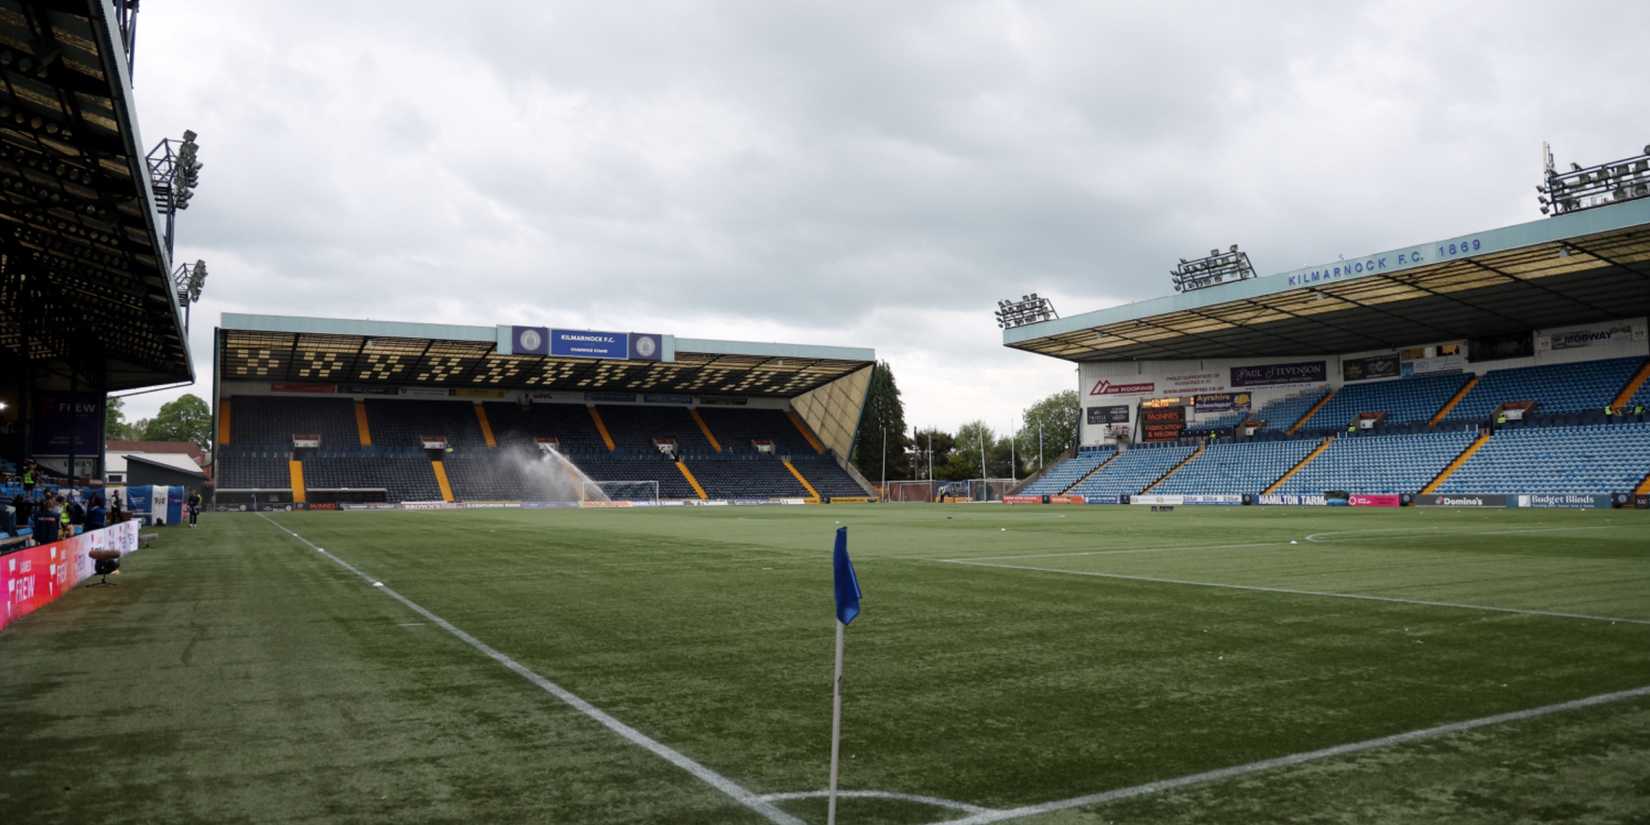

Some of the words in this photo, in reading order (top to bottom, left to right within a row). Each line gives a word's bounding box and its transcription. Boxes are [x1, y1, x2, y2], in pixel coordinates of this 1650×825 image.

[1288, 257, 1387, 287] KILMARNOCK
[1398, 251, 1424, 266] F.C.
[1438, 239, 1482, 258] 1869
[561, 334, 602, 342] KILMARNOCK
[1264, 364, 1321, 379] STEVENSON
[1196, 394, 1230, 405] Ayrshire
[1258, 495, 1299, 505] HAMILTON
[1301, 495, 1327, 505] TARM
[1443, 496, 1483, 506] Domino's
[1531, 495, 1565, 505] Budget
[1566, 495, 1595, 504] Blinds
[16, 573, 36, 604] FREW
